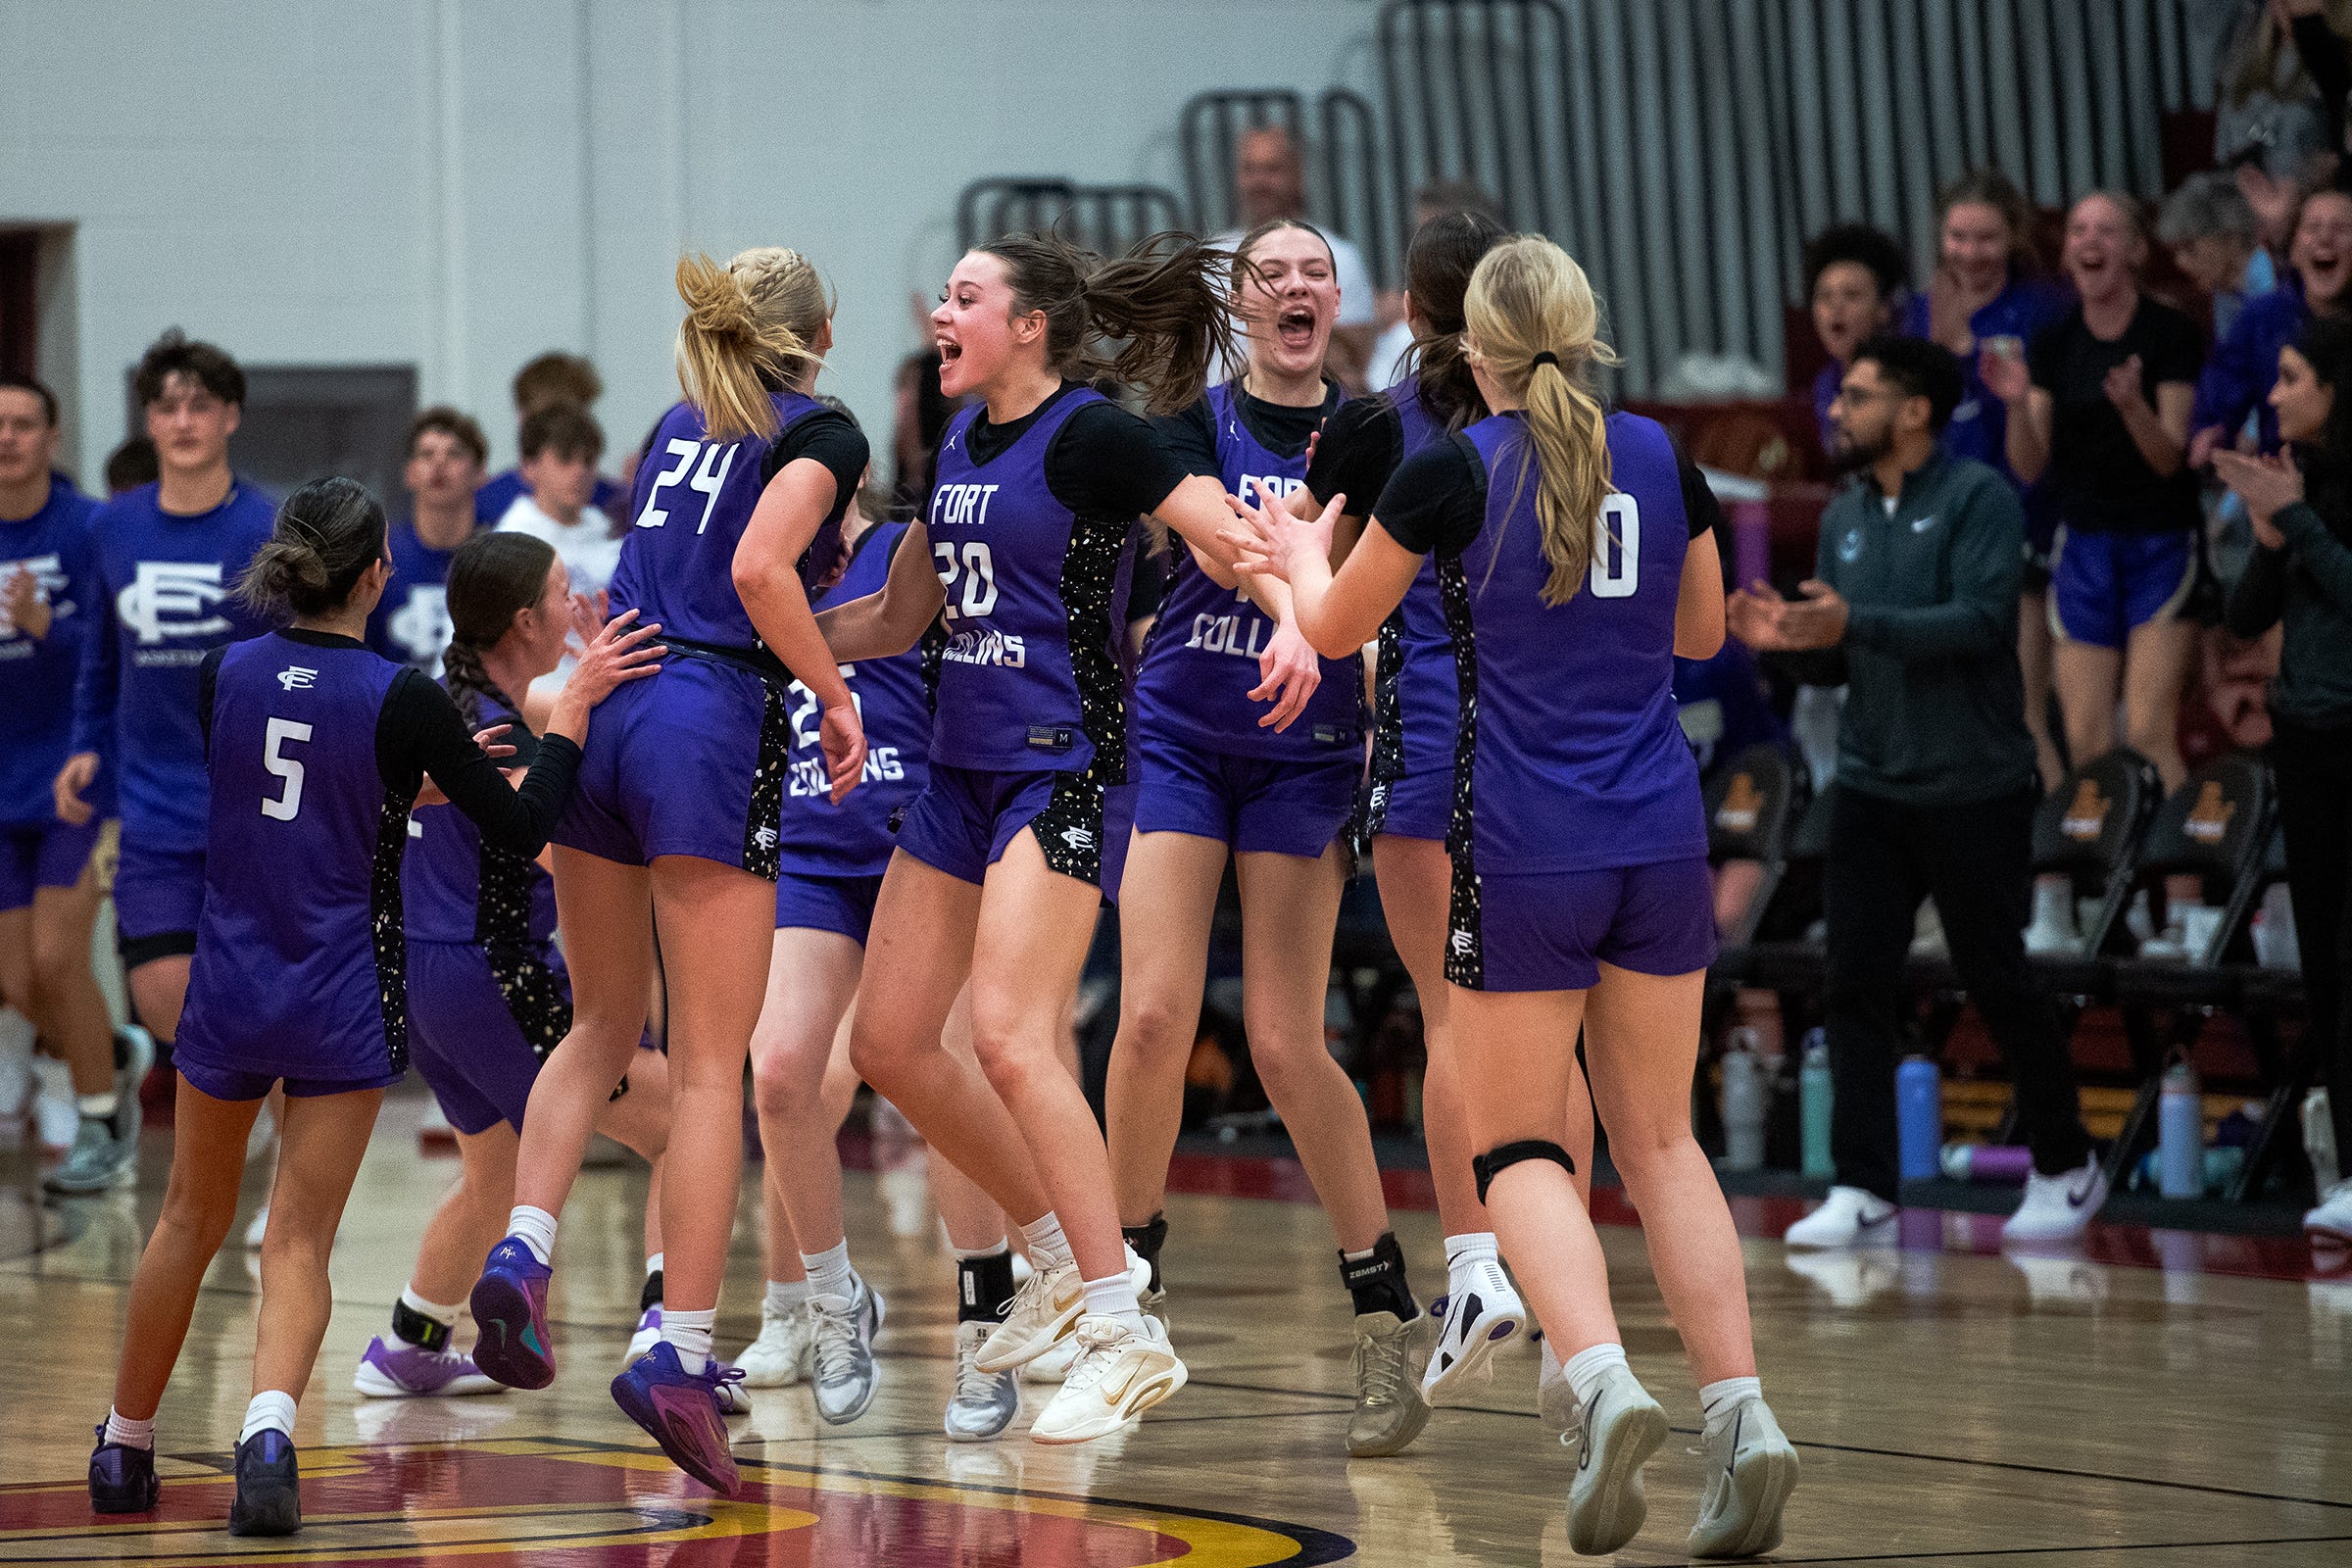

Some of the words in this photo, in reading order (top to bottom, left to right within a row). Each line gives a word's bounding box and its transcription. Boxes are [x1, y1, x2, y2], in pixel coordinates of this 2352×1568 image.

[635, 437, 741, 535] 24
[931, 484, 1000, 524] FORT
[1591, 493, 1640, 599] 0
[935, 542, 999, 617] 20
[1185, 612, 1280, 660] COLL
[262, 716, 314, 821] 5
[1059, 733, 1068, 743] M
[789, 747, 905, 797] COLNS
